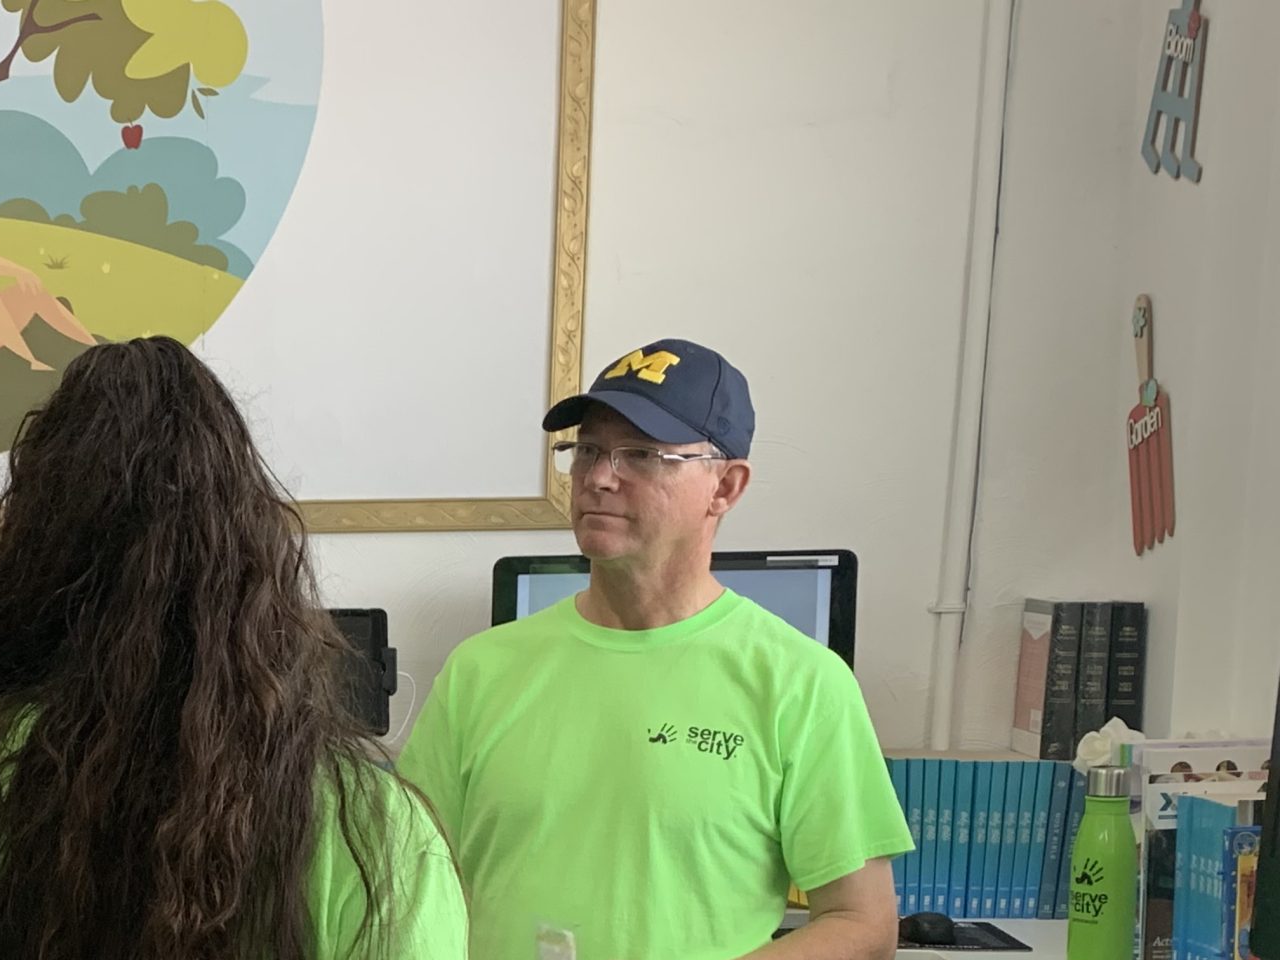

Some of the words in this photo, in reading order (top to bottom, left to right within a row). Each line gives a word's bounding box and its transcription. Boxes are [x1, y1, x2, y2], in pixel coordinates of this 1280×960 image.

[1166, 23, 1194, 63] Bloom
[604, 350, 681, 385] M
[1127, 406, 1161, 450] Garden
[687, 726, 744, 746] serve
[697, 740, 737, 760] city.
[1074, 901, 1104, 917] city.
